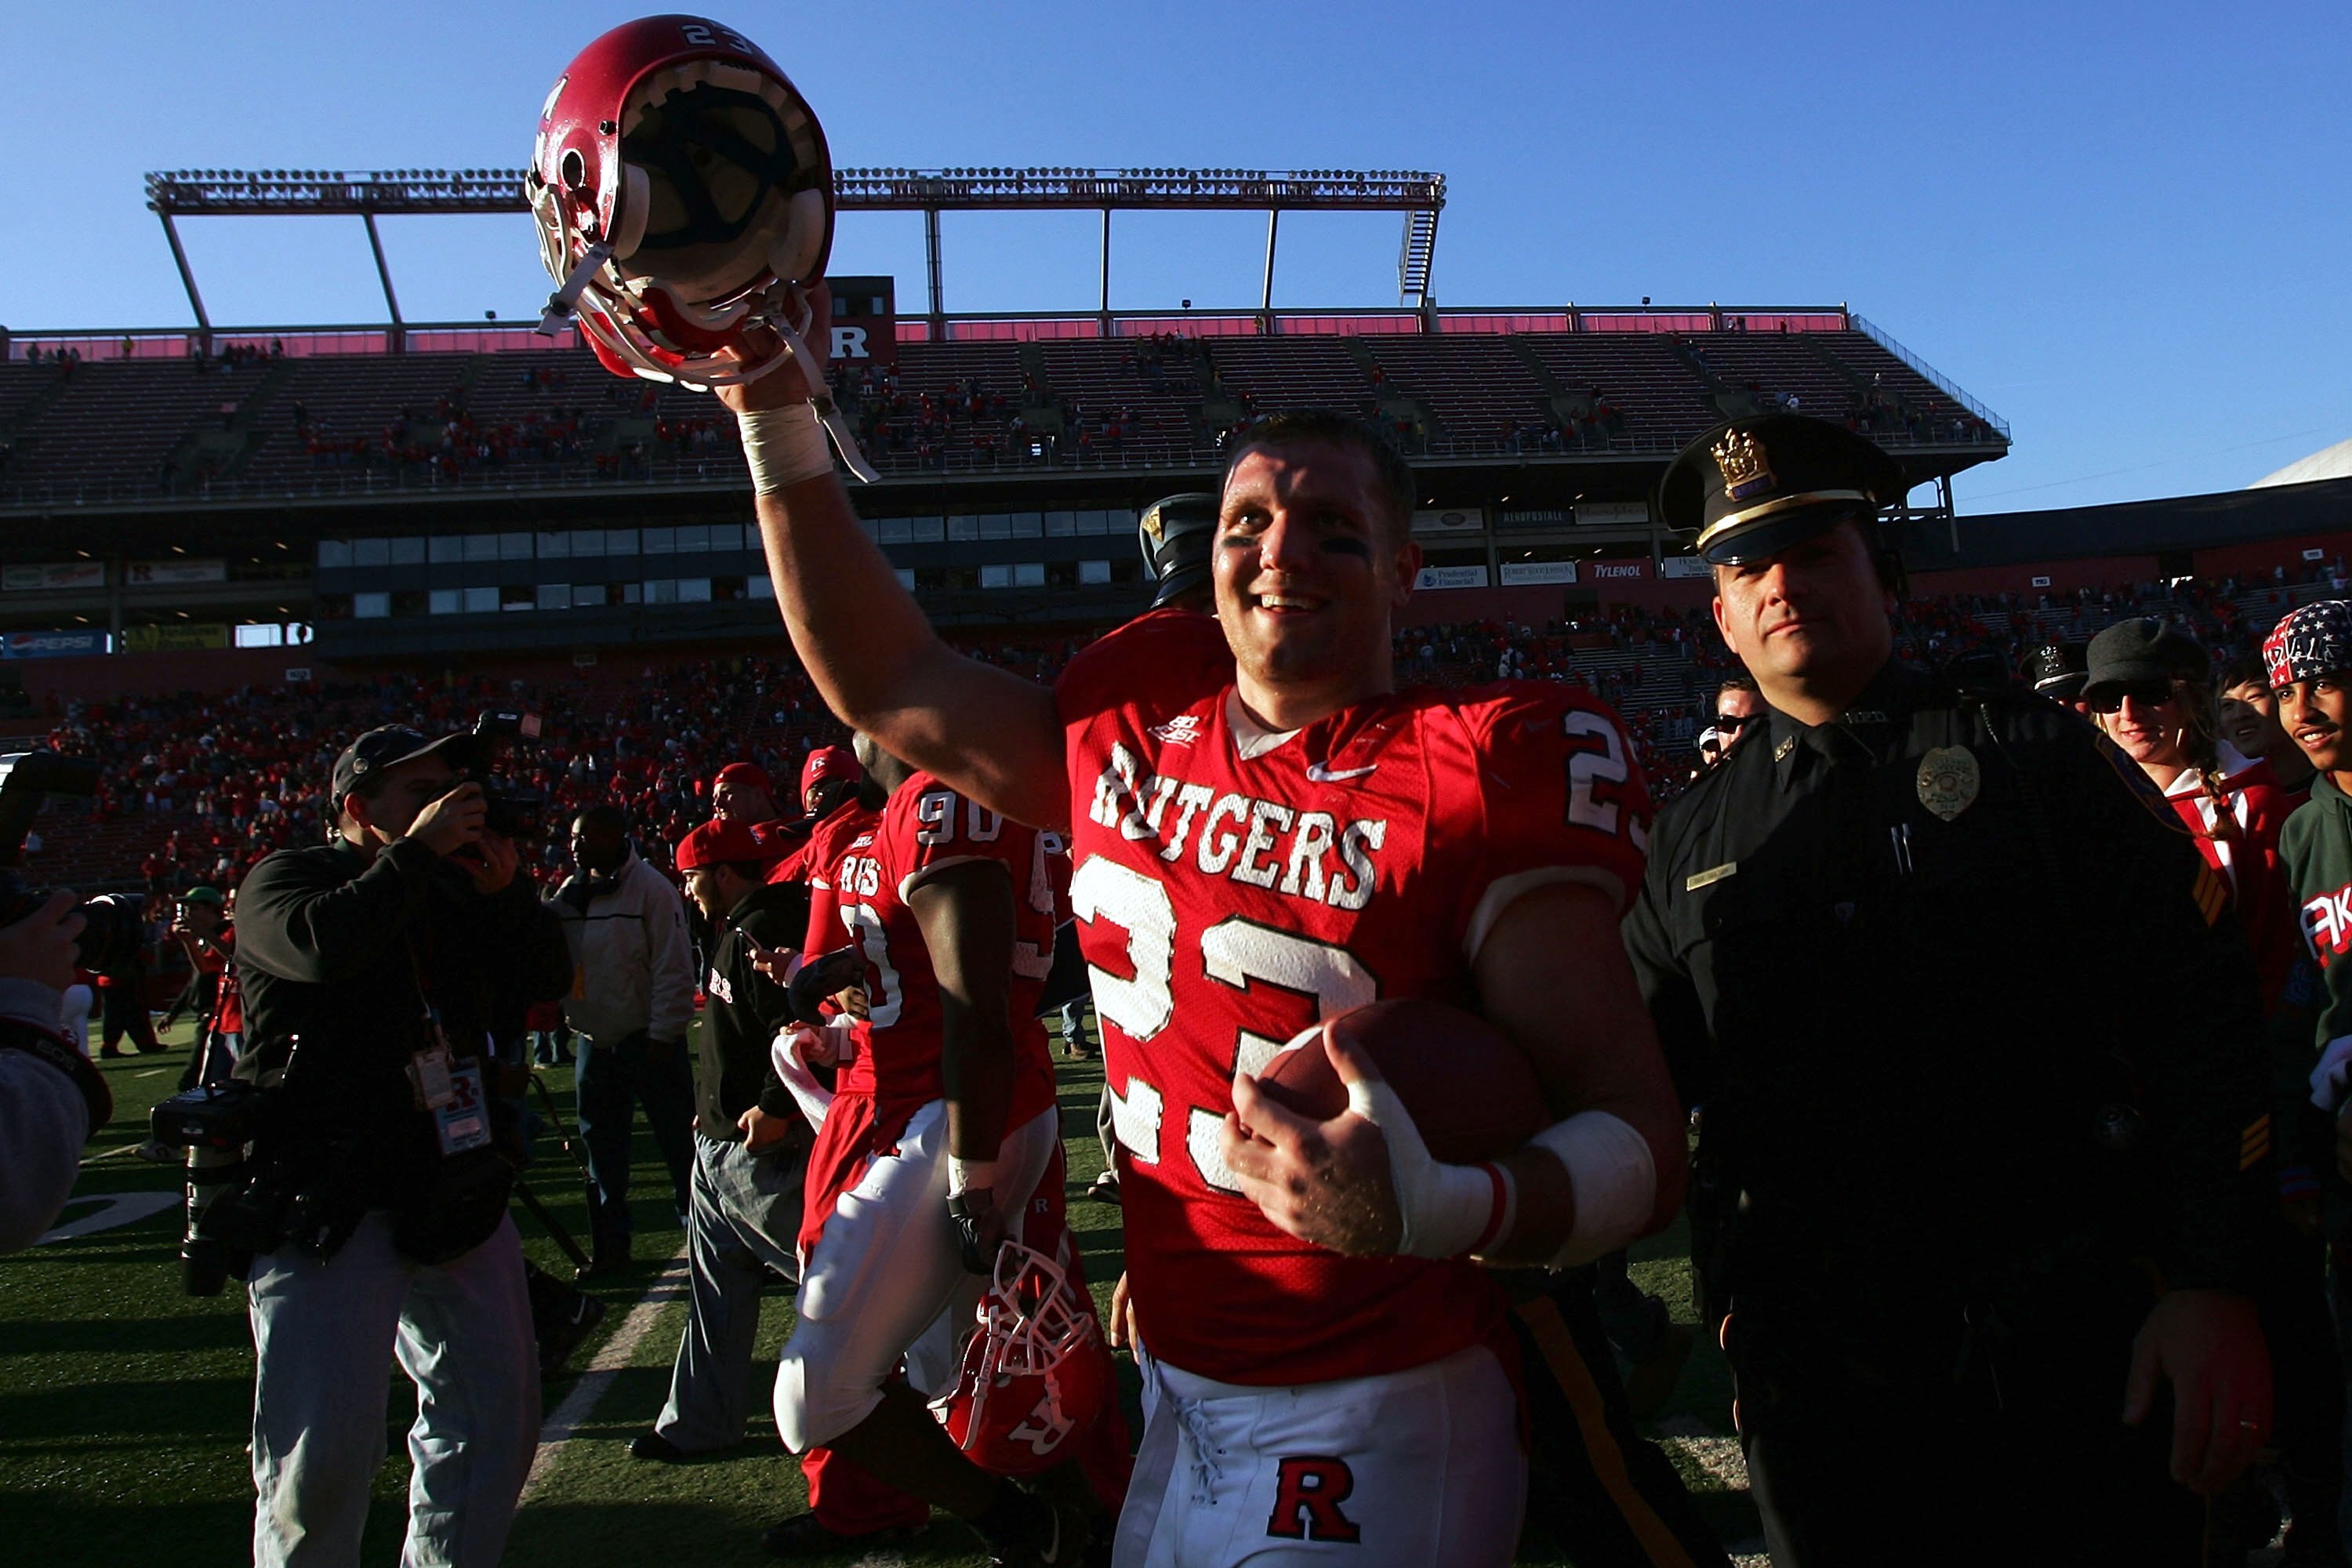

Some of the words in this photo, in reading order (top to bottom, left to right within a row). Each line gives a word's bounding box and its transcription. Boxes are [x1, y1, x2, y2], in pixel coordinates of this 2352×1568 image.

[681, 24, 753, 54] 23
[829, 326, 869, 358] R
[1594, 564, 1642, 578] TYLENOL
[37, 636, 94, 650] PEPSI
[1088, 740, 1388, 911] RUTGERS
[1034, 1199, 1049, 1214] R
[1267, 1456, 1361, 1544] R
